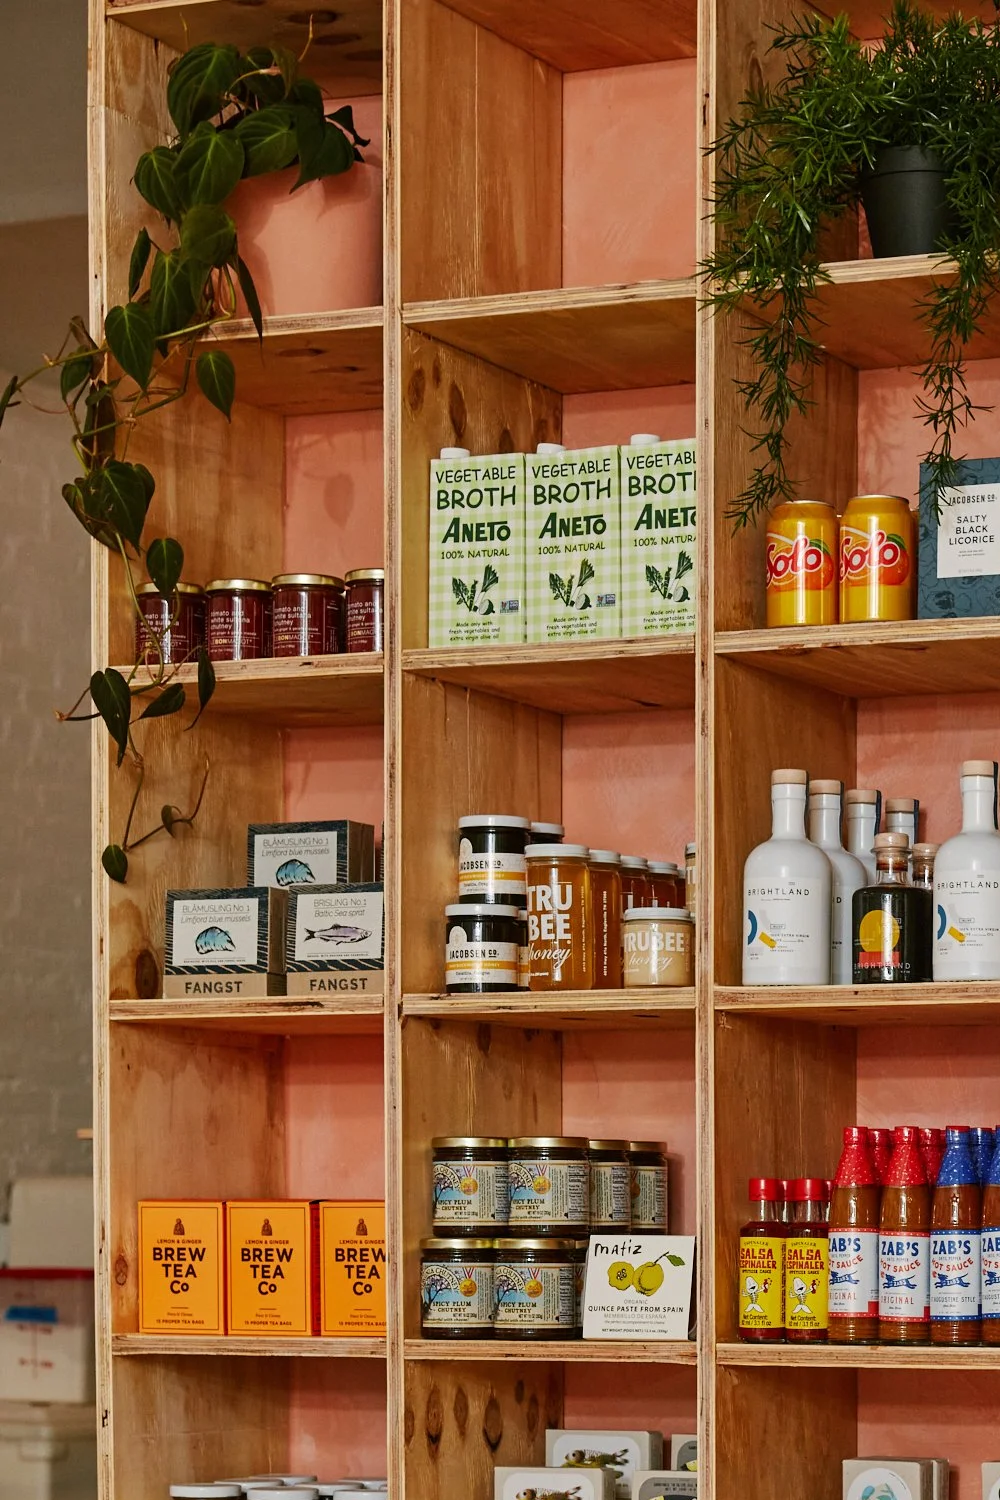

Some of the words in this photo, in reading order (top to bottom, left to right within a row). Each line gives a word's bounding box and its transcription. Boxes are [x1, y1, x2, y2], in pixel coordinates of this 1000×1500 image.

[436, 466, 516, 484] VEGETABLE
[532, 458, 611, 479] VEGETABLE
[436, 486, 516, 510] BROTH
[533, 478, 611, 506] BROTH
[957, 514, 987, 524] SALTY
[955, 525, 988, 534] BLACK
[949, 535, 995, 545] LICORICE
[441, 550, 464, 559] 100%
[468, 548, 510, 558] NATURAL
[538, 546, 561, 555] 100%
[564, 542, 605, 553] NATURAL
[767, 537, 823, 588] Solo
[840, 530, 900, 582] Solo
[748, 888, 810, 896] BRIGHTLAND
[937, 881, 999, 890] BRIGHTLAND
[349, 909, 365, 918] sprat
[449, 951, 486, 960] JACOBSEN
[529, 946, 571, 967] honey
[185, 981, 242, 993] FANGST
[310, 979, 367, 991] FANGST
[882, 1242, 919, 1256] ZAB'S
[932, 1240, 970, 1255] ZAB'S
[153, 1248, 206, 1261] BREW
[241, 1248, 293, 1262] BREW
[740, 1249, 774, 1260] SALSA
[787, 1249, 822, 1261] SALSA
[162, 1264, 197, 1278] TEA
[740, 1259, 776, 1270] ESPINALER
[893, 1260, 921, 1272] SAUCE
[946, 1258, 974, 1271] SAUCE
[250, 1265, 284, 1279] TEA
